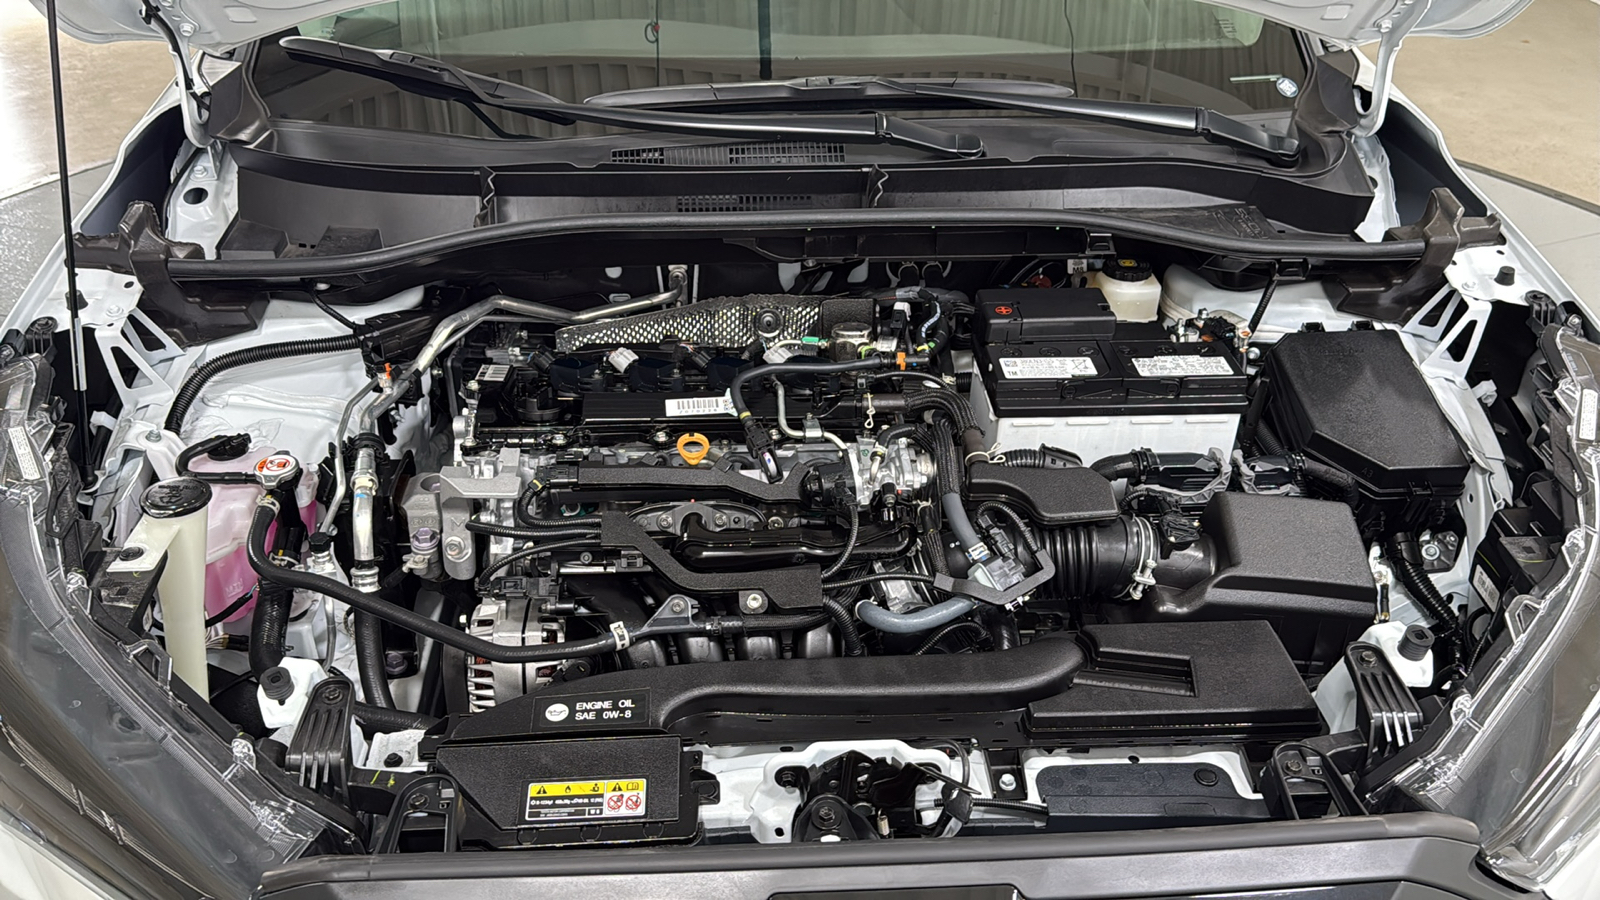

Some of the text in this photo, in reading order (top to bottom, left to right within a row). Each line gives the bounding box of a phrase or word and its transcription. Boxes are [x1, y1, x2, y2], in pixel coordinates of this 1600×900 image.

[575, 699, 635, 711] ENGINE OIL
[575, 710, 632, 720] SAE 0W-8
